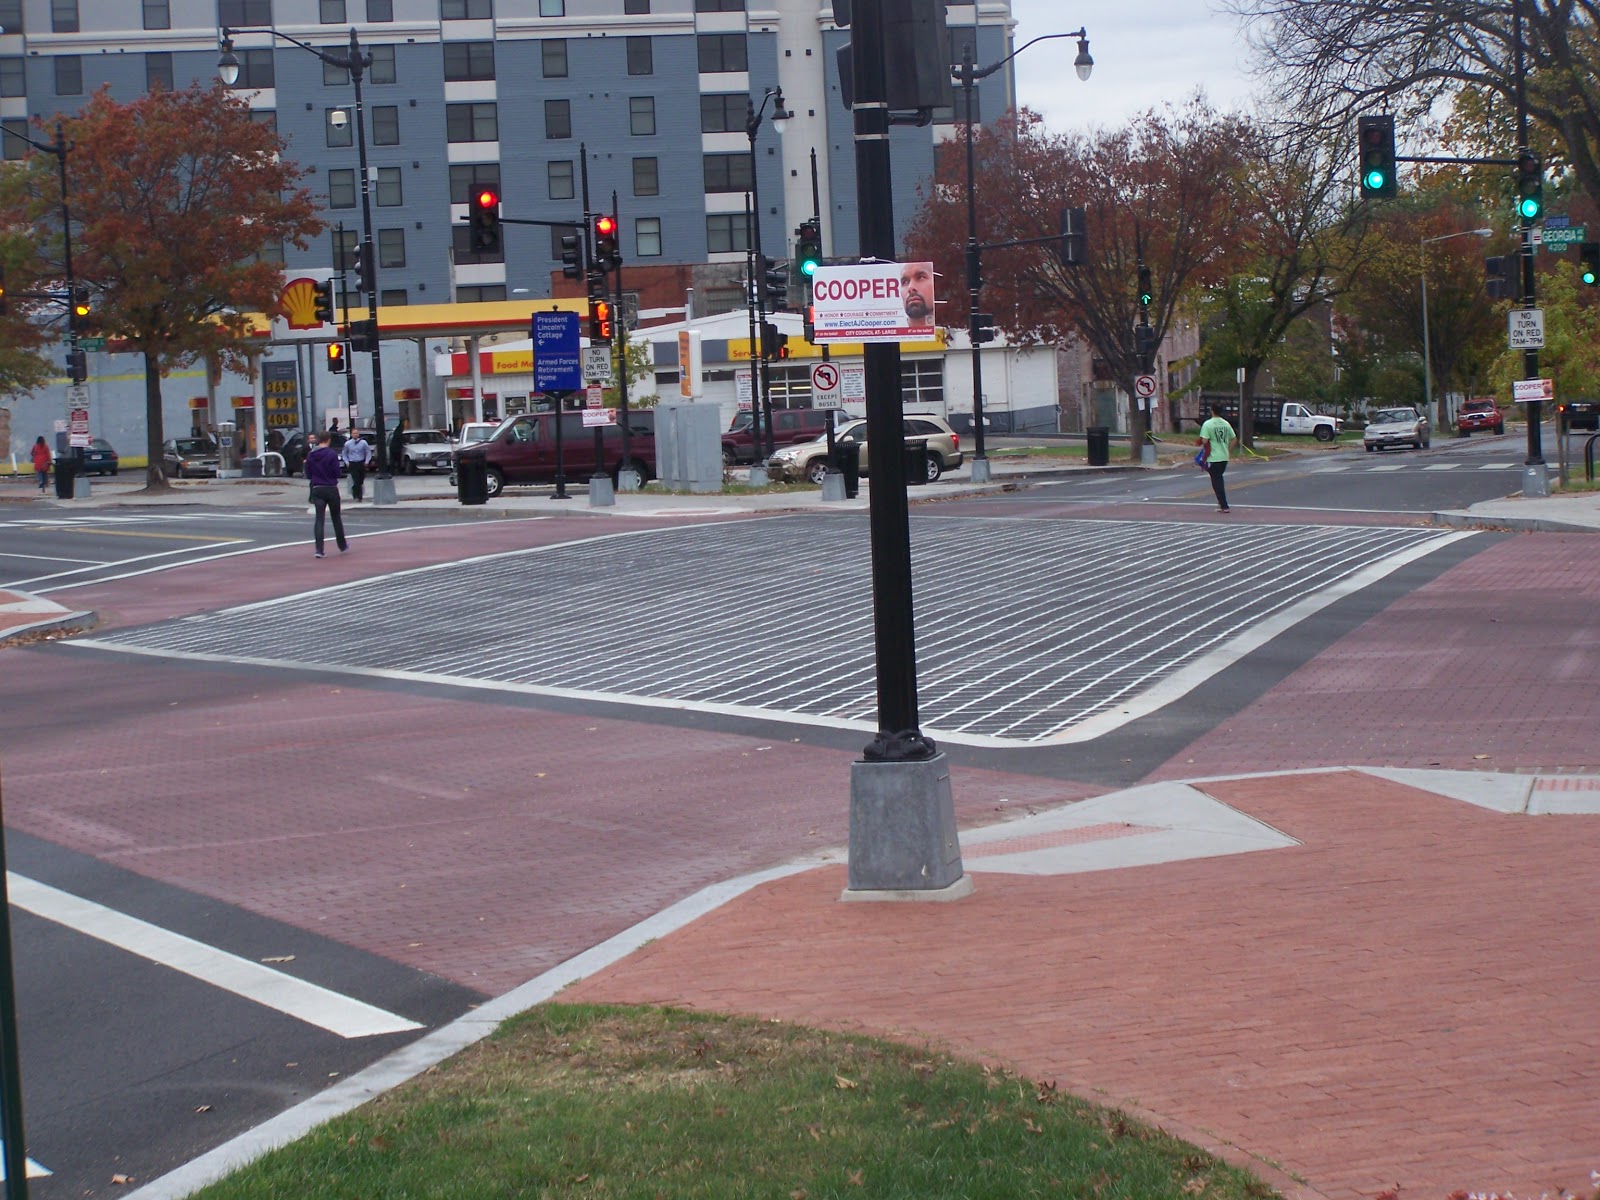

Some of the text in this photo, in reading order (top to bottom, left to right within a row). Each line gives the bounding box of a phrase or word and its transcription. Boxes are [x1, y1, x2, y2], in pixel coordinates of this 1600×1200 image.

[1542, 230, 1576, 242] GEORGIA
[1548, 243, 1568, 251] 4200
[814, 278, 900, 301] COOPER
[1521, 312, 1531, 320] NO
[824, 319, 896, 328] www.ElectAJCooper.com
[1517, 321, 1536, 329] TURN
[1513, 329, 1541, 338] ON RED
[497, 360, 534, 370] Food Ma
[1514, 383, 1542, 391] COOPER
